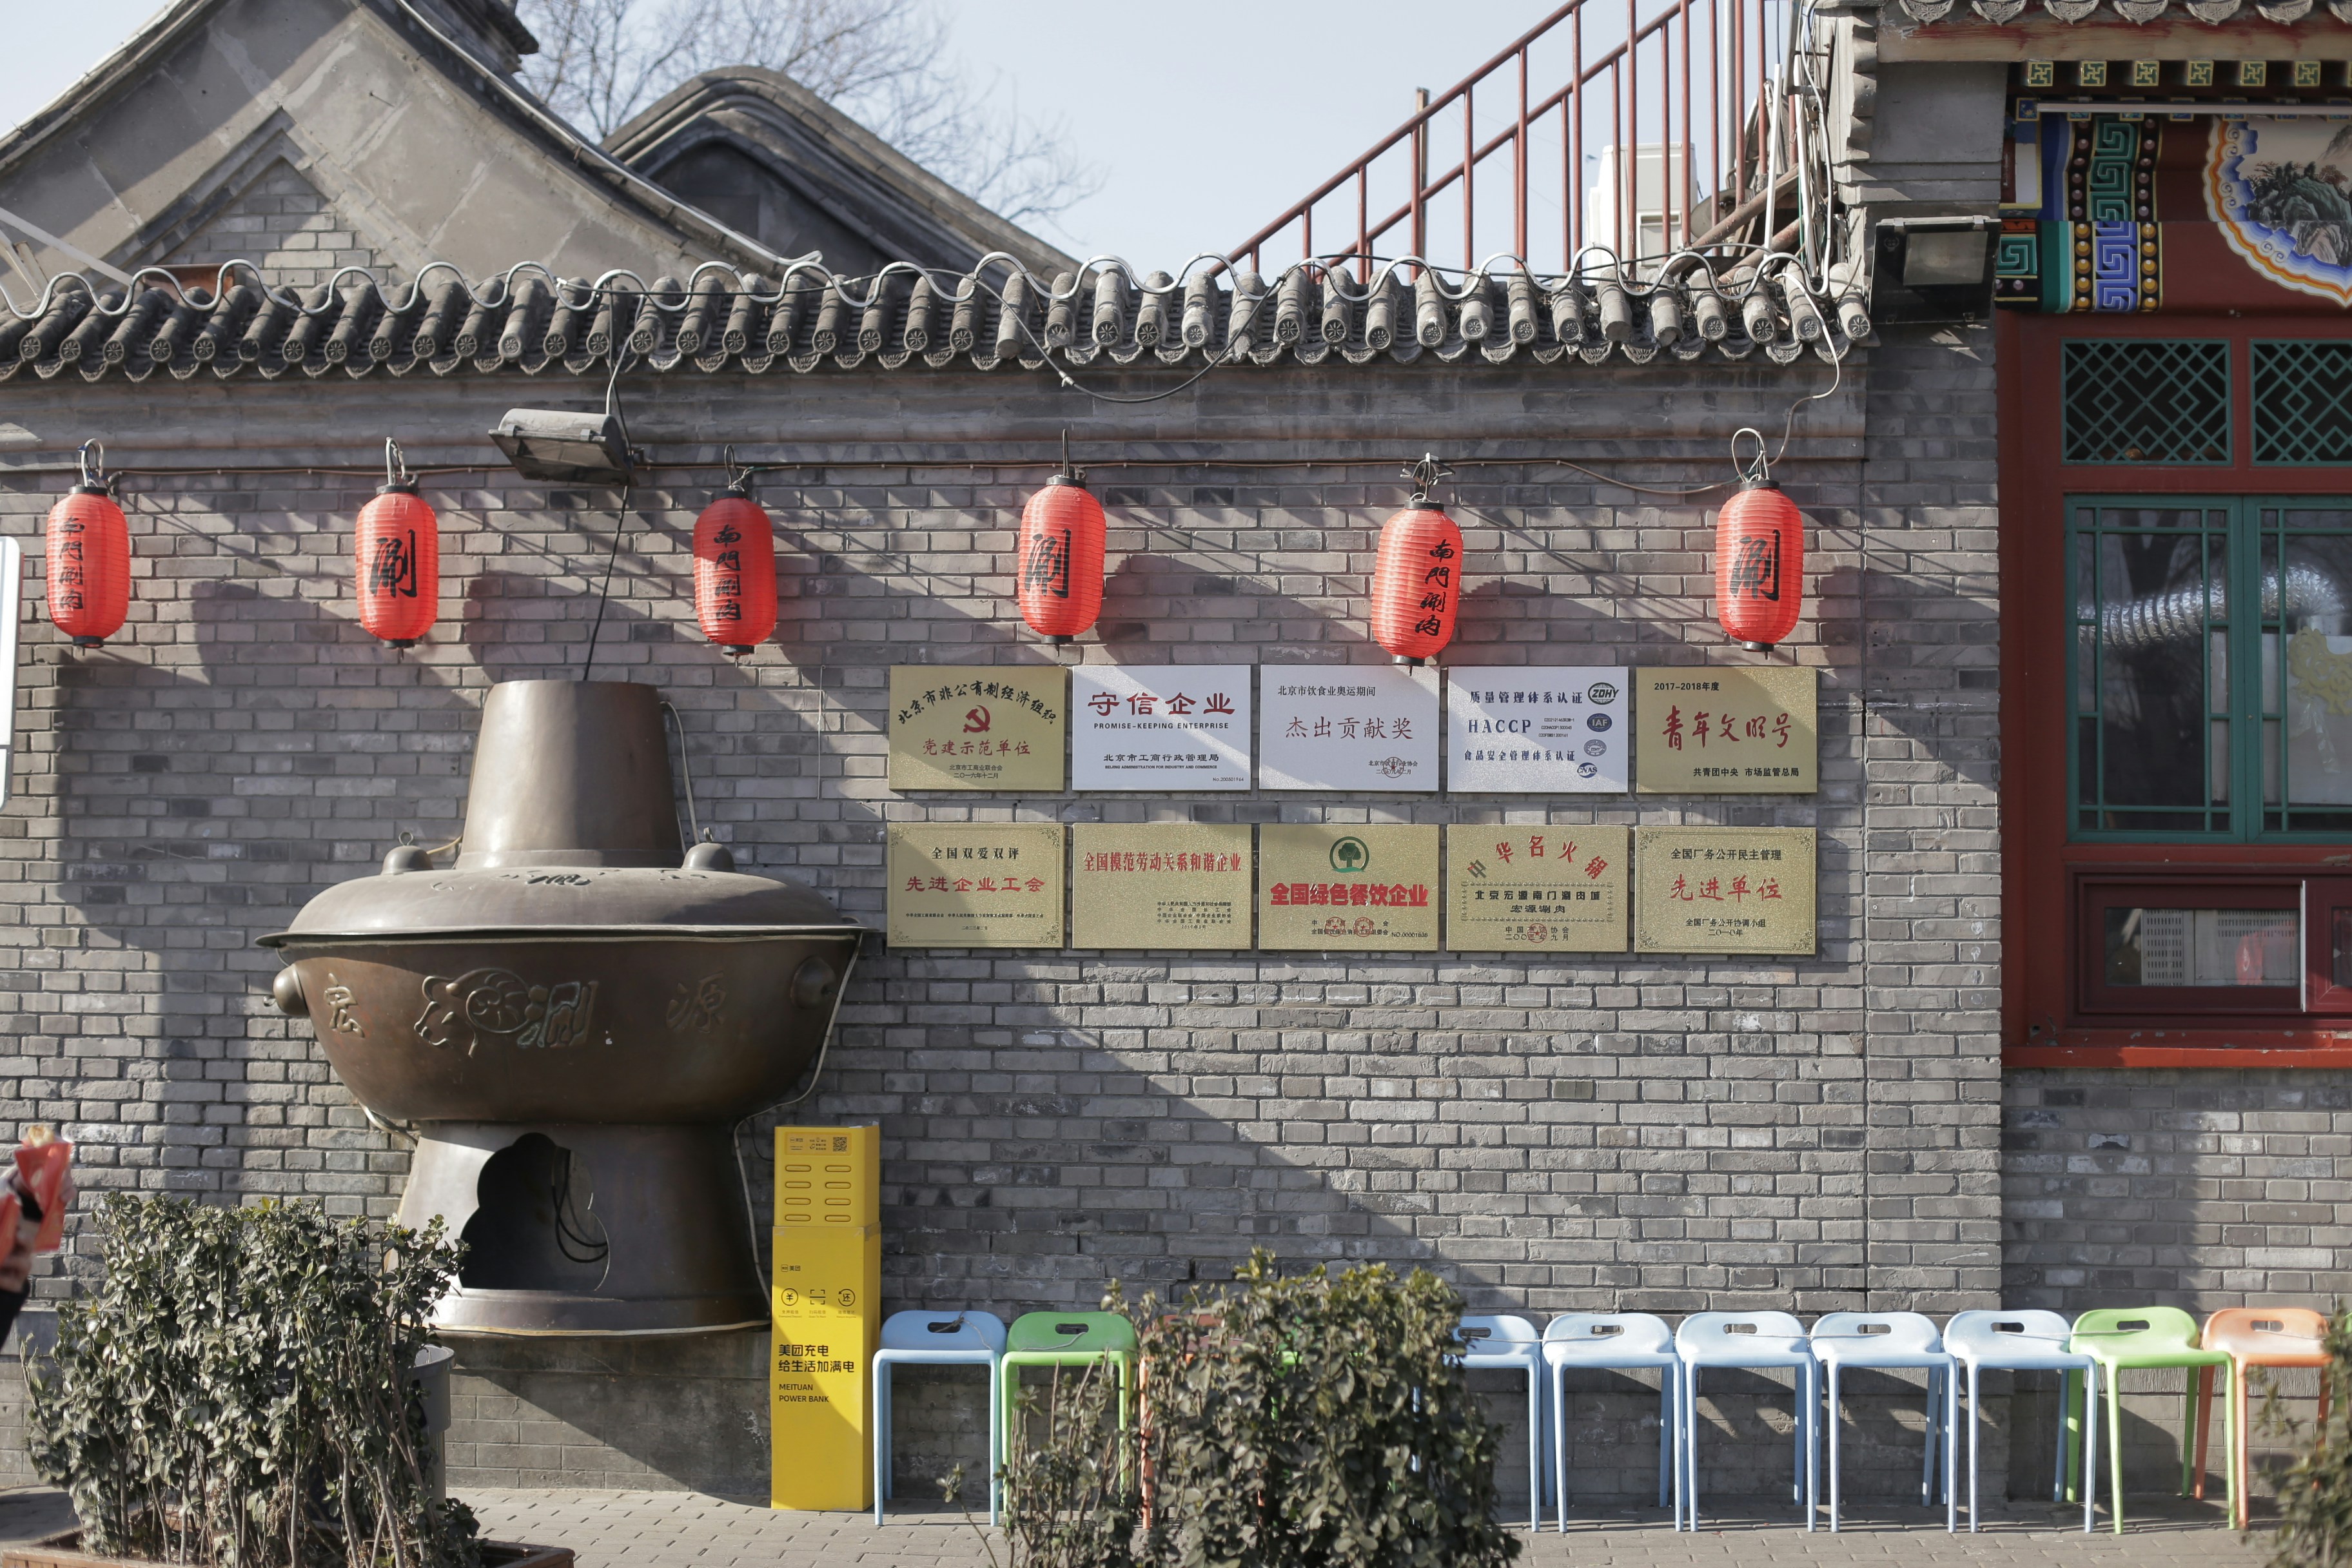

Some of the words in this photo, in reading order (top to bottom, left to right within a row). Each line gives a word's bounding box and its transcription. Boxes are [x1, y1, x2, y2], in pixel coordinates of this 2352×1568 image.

[1277, 685, 1376, 697] 北京市饮食业奥运期间
[1470, 691, 1583, 704] 质量管理体系认证
[1087, 691, 1235, 716] 守信企业
[1286, 716, 1413, 740] 杰出贡献奖
[1468, 720, 1531, 734] HACCP
[922, 738, 1031, 757] 党建示范单位
[1103, 753, 1219, 762] 北京市工商行政管理局
[1464, 749, 1576, 762] 食品安全管理体系认证
[1693, 767, 1739, 777] 共青团中央
[1744, 767, 1799, 778] 市场监管总局
[931, 847, 1019, 860] 全国双爱双评
[1466, 834, 1609, 880] 中华名火锅
[1671, 848, 1782, 861] 全国厂务公开民主管理
[1083, 851, 1242, 872] 全国模范劳动关系和谐企业
[905, 876, 1046, 892] 先进企业工会
[1669, 873, 1782, 903] 先进单位
[1269, 882, 1429, 907] 全国绿色餐饮企业
[1475, 890, 1600, 901] 北京宏源南门涮肉城
[1509, 904, 1566, 914] 宏源涮肉
[1685, 917, 1766, 928] 全国厂务公开协调小组
[779, 1344, 828, 1357] 美团充电
[778, 1360, 854, 1373] 给生活加满电
